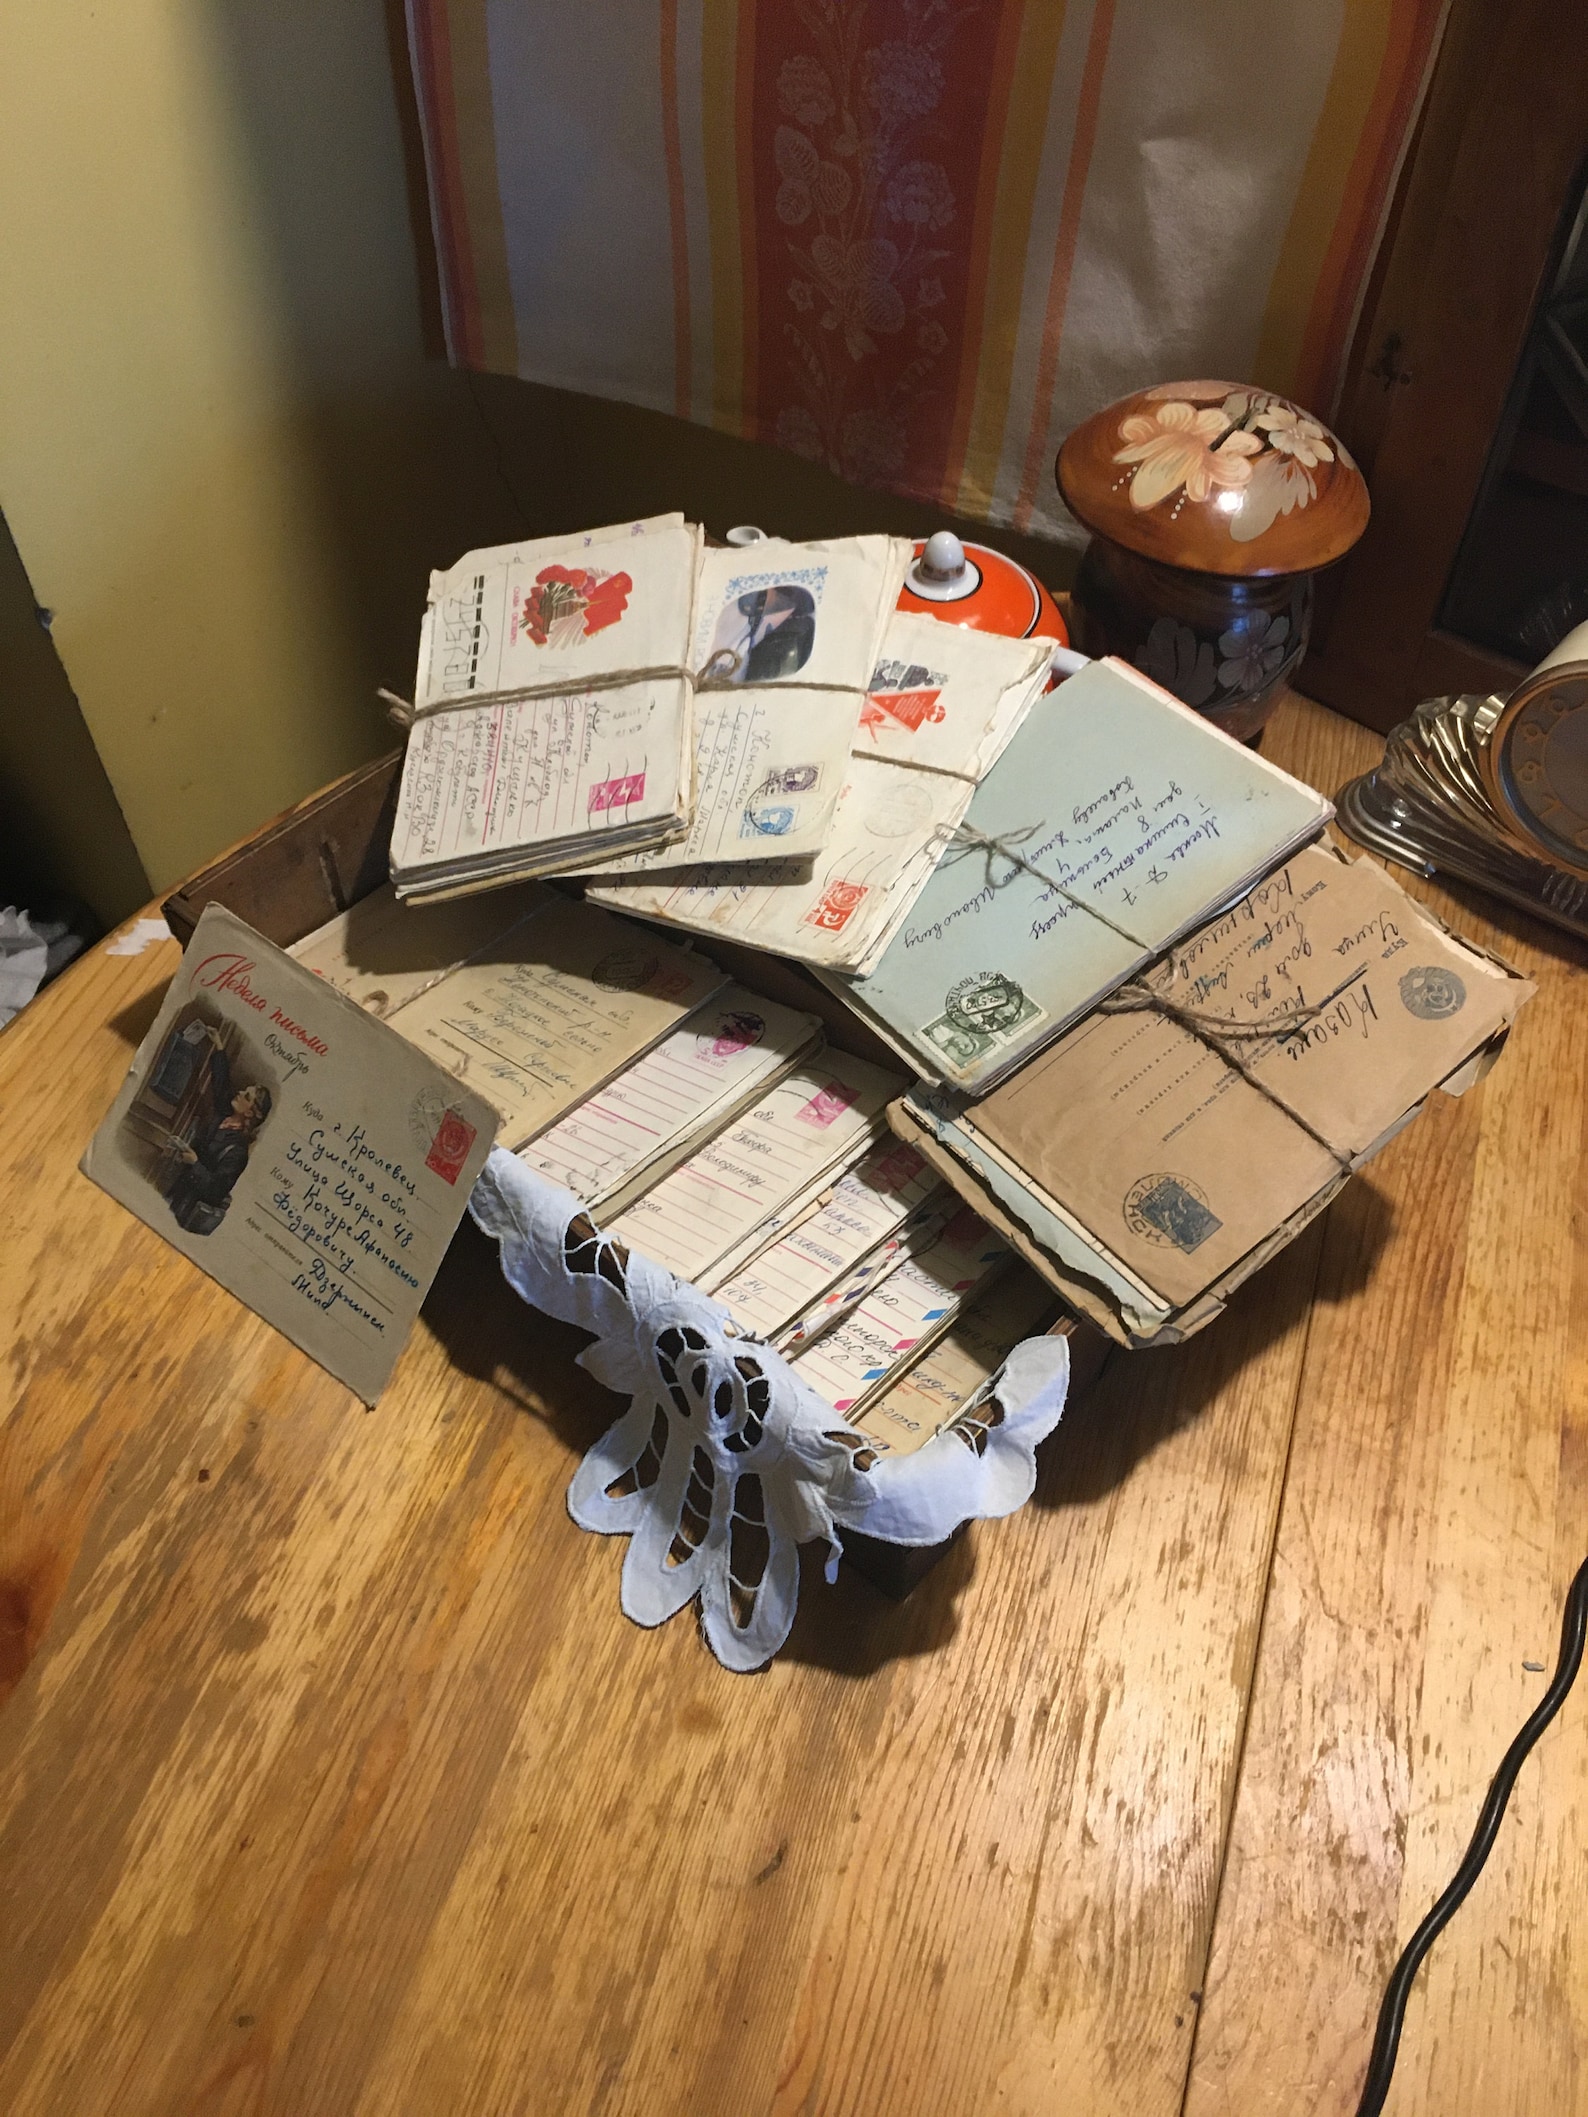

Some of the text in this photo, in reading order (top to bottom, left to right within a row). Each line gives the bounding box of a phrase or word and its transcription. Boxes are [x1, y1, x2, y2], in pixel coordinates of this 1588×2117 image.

[1137, 816, 1150, 833] 8
[1166, 815, 1222, 863] Москва
[1332, 910, 1399, 957] Улица
[1381, 937, 1409, 960] Куда
[189, 953, 328, 1057] Неделя письма
[264, 1033, 309, 1083] Октябрь
[302, 1101, 324, 1121] Куда
[270, 1167, 294, 1189] Кому
[286, 1142, 329, 1185] Улица
[335, 1181, 384, 1226] Щорса
[309, 1130, 375, 1194] Сумская
